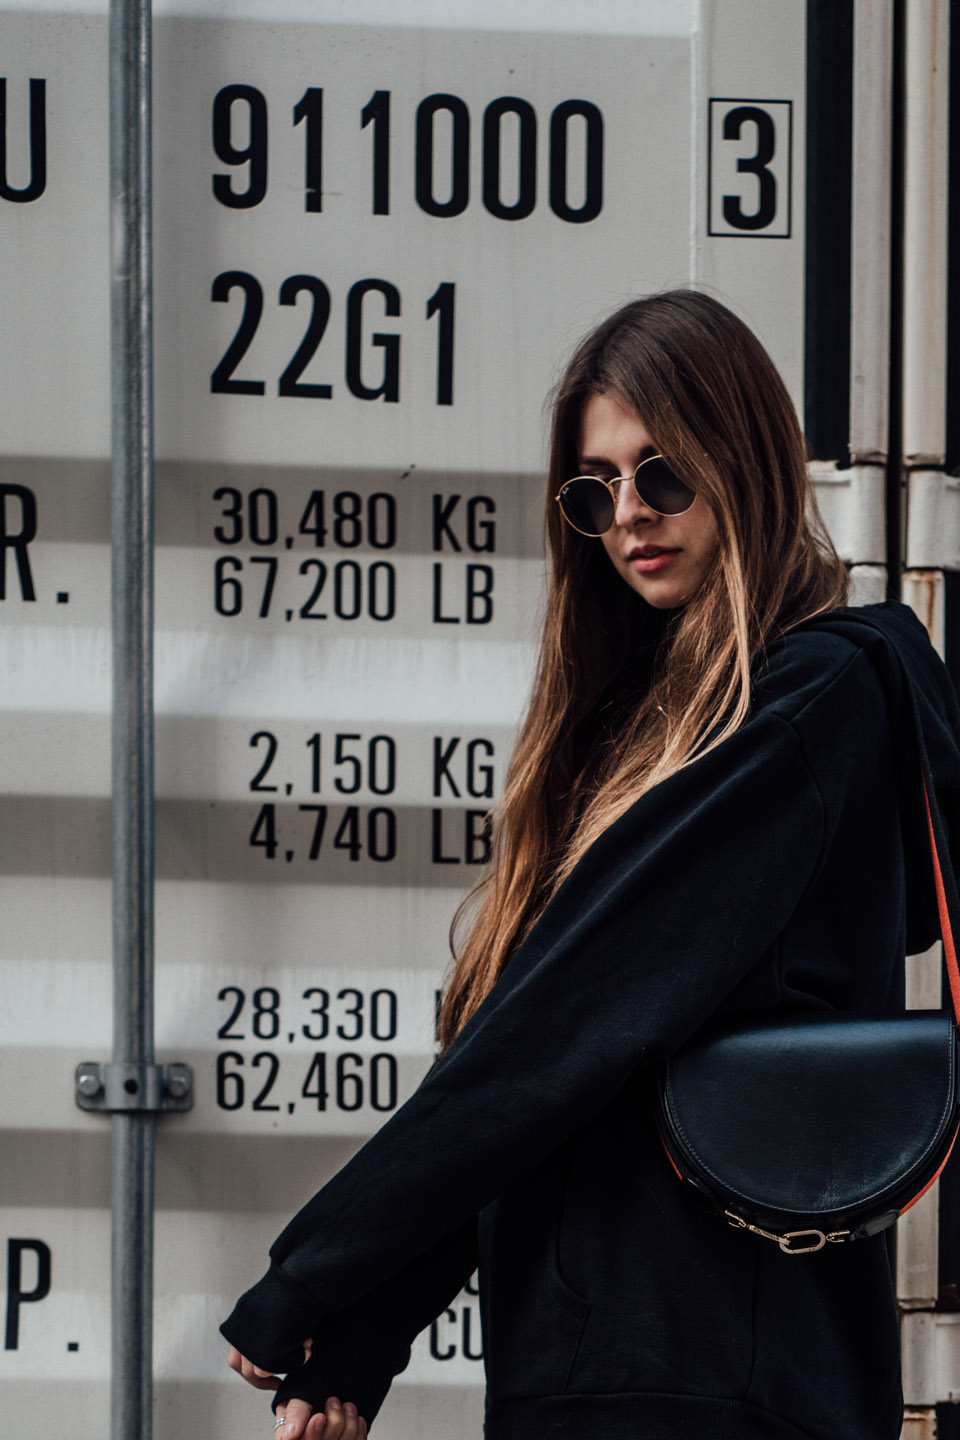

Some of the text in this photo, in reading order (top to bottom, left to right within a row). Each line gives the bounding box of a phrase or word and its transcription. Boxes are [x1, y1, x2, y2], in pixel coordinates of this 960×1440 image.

[211, 83, 604, 224] 911000
[721, 106, 777, 231] 3
[209, 270, 456, 406] 22G1
[212, 486, 496, 553] 30,480 KG
[214, 555, 494, 625] 67,200 LB
[249, 730, 495, 799] 2,150 KG
[249, 803, 493, 865] 4,740 LB
[217, 986, 398, 1043] 28,330
[215, 1051, 398, 1114] 62,460
